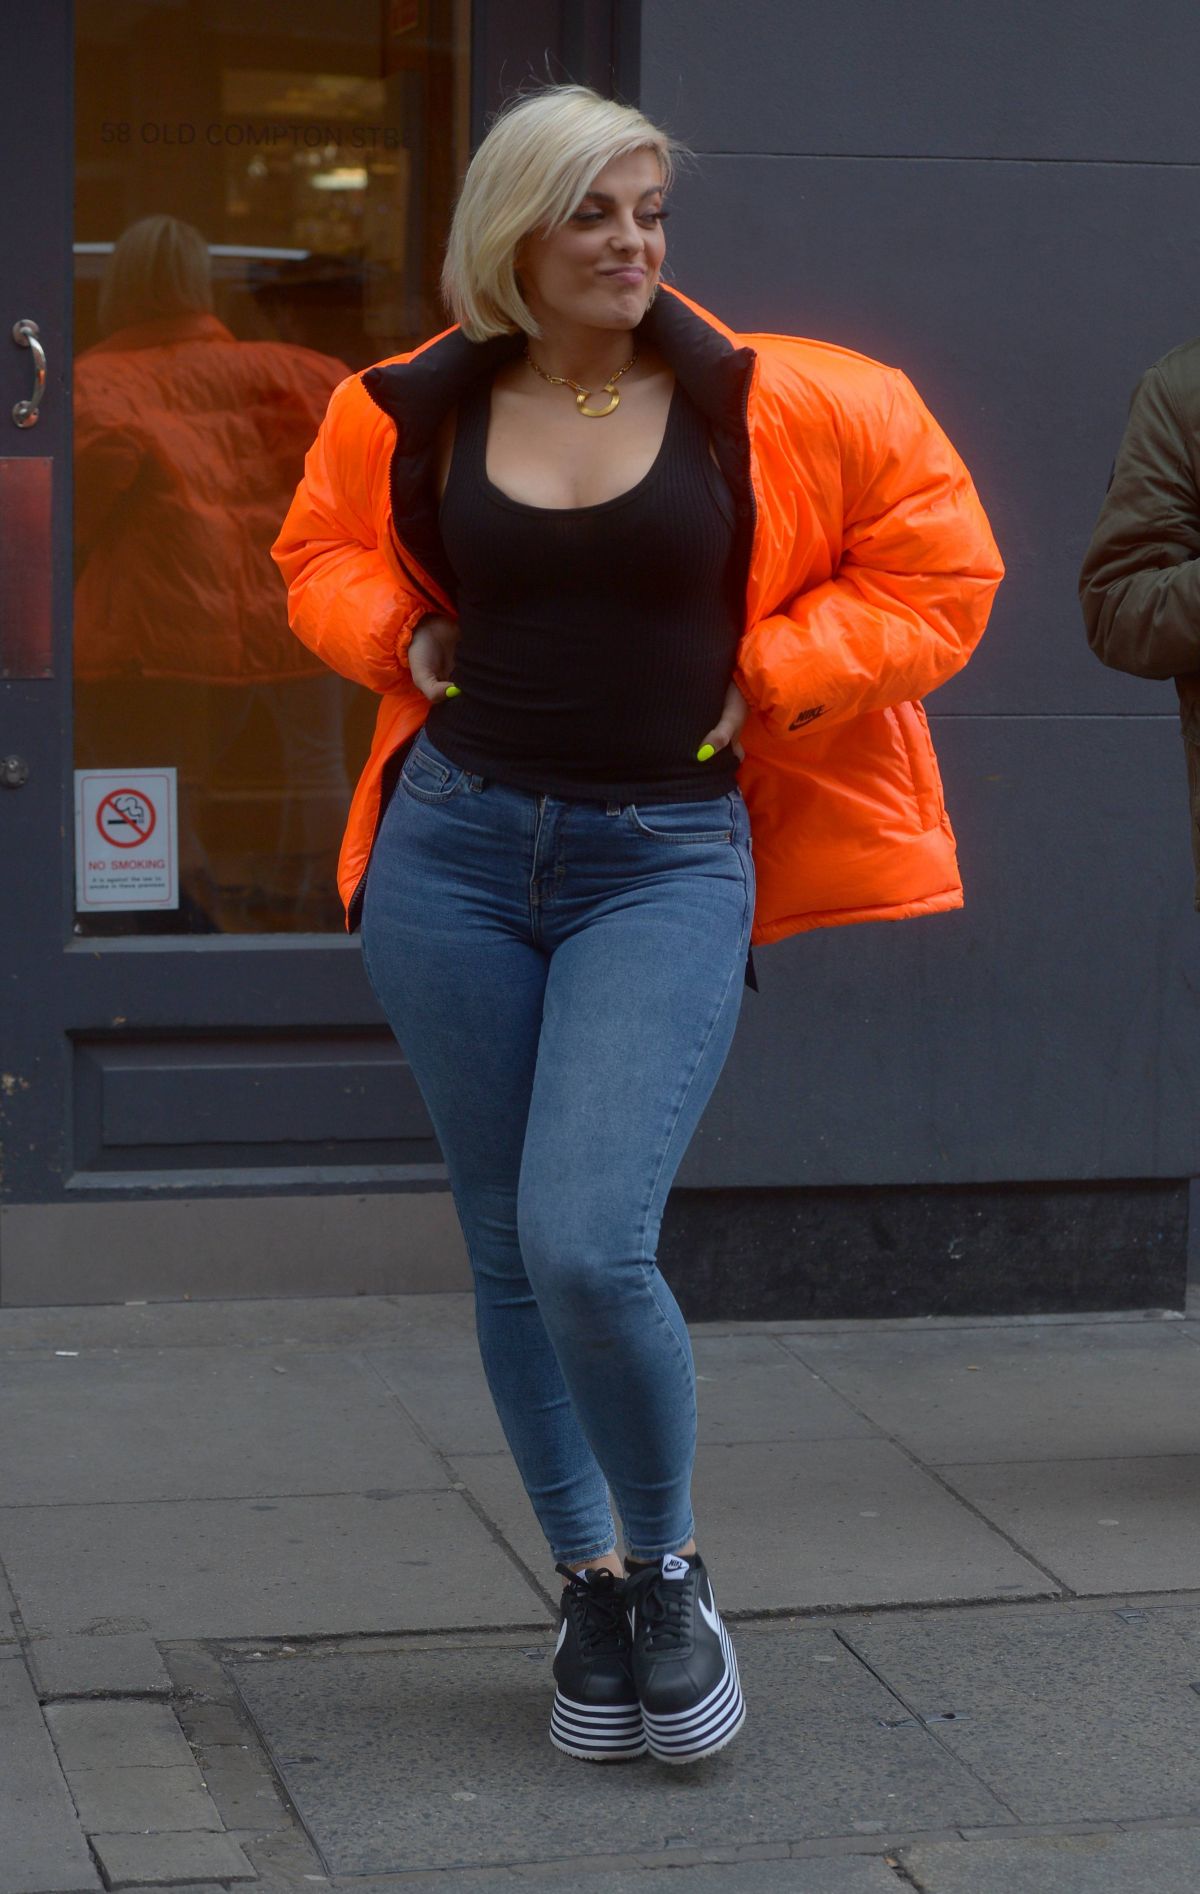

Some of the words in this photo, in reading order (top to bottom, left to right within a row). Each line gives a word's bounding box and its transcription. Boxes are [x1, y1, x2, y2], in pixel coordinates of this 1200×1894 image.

[101, 122, 131, 143] 58
[140, 122, 195, 144] OLD
[206, 123, 343, 147] COMPTON
[88, 861, 106, 870] NO
[111, 860, 165, 870] SMOKING
